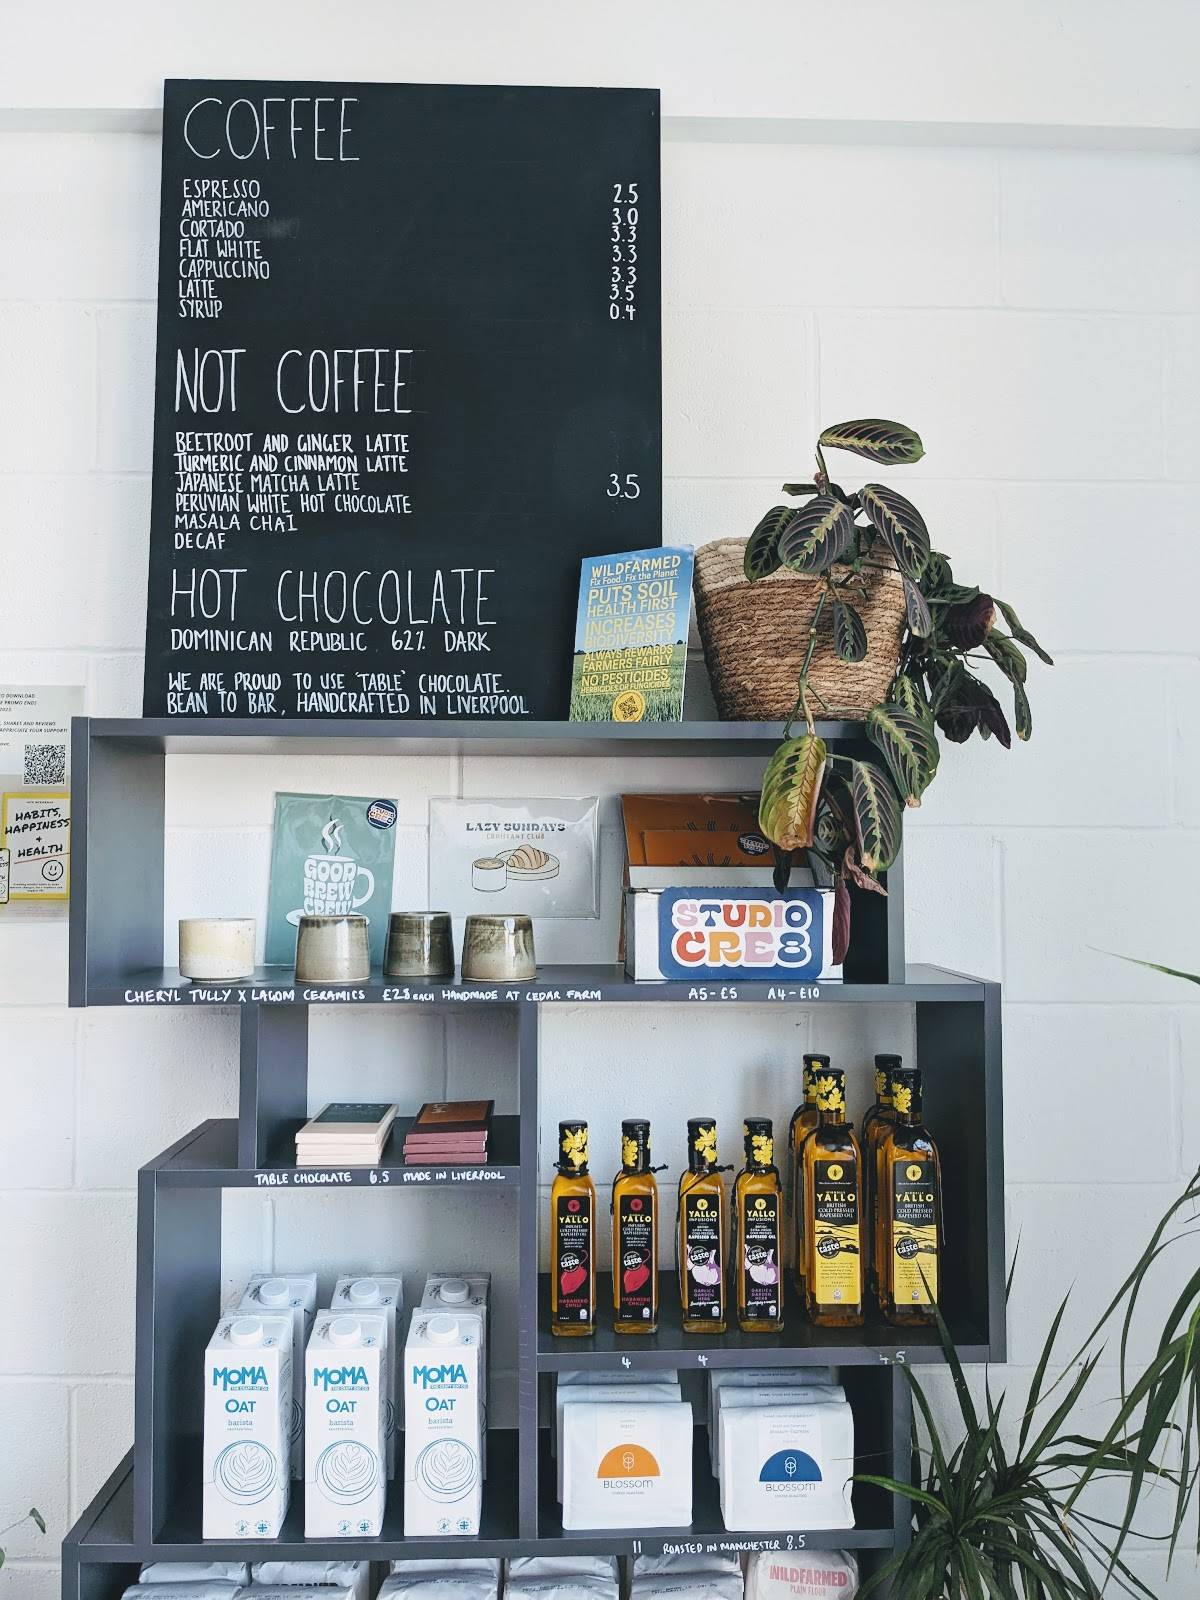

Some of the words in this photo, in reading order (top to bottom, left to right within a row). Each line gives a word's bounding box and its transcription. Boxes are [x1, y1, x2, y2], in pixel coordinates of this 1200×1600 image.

[184, 98, 360, 160] COFFEE
[184, 179, 260, 199] ESPRESSO
[614, 184, 638, 204] 2.5
[182, 200, 270, 218] AMERICANO
[611, 208, 638, 226] 3.0
[180, 220, 244, 238] CORTADO
[610, 226, 636, 242] 3.3
[180, 239, 209, 258] FLAT
[217, 240, 262, 260] WHITE
[612, 244, 638, 263] 3.3
[179, 259, 270, 280] CAPPUCCINO
[612, 266, 637, 284] 3.3
[179, 279, 218, 298] LATTE
[610, 284, 634, 301] 3.5
[179, 299, 222, 318] SYRUP
[610, 303, 636, 320] 0.4
[175, 348, 246, 413] NOT
[276, 349, 413, 414] COFFEE
[176, 432, 253, 453] BEETROOT
[262, 434, 288, 452] AND
[298, 434, 354, 453] GINGER
[366, 434, 410, 452] LATTE
[174, 453, 244, 472] TURMERIC
[249, 454, 278, 472] AND
[284, 454, 358, 472] CINNAMON
[366, 454, 409, 472] LATTE
[175, 472, 244, 493] JAPANESE
[250, 474, 310, 492] MATCHA
[318, 473, 360, 492] LATTE
[606, 473, 640, 499] 3.5
[176, 493, 240, 512] PERUVIAN
[246, 494, 291, 514] WHITE
[300, 494, 326, 514] HOT
[334, 494, 412, 514] CHOCOLATE
[175, 514, 240, 530] MASALA
[250, 514, 298, 532] CHAI
[174, 533, 226, 550] DECAF
[592, 556, 681, 578] WILDFARMED
[590, 578, 600, 587] Fix
[602, 576, 622, 586] Food.
[626, 574, 636, 582] Fix
[638, 572, 651, 580] the
[653, 568, 678, 579] Planet
[170, 568, 248, 622] HOT
[278, 569, 496, 626] CHOCOLATE
[588, 584, 632, 605] PUTS
[637, 580, 678, 599] SOIL
[588, 601, 636, 618] HEALTH
[640, 596, 678, 612] FIRST
[584, 612, 676, 638] INCREASES
[171, 628, 272, 652] DOMINICAN
[290, 631, 368, 652] REPUBLIC
[391, 630, 426, 652] 62%
[445, 630, 491, 652] DARK
[584, 628, 675, 648] BIODIVERSITY
[584, 649, 622, 662] ALWAYS
[624, 644, 674, 658] REWARDS
[582, 657, 632, 672] FARMERS
[636, 654, 672, 668] FAIRLY
[168, 672, 192, 691] WE
[200, 672, 226, 692] ARE
[234, 672, 282, 692] PROUD
[293, 672, 312, 690] TO
[320, 673, 345, 690] USE
[419, 674, 510, 694] CHOCOLATE.
[580, 684, 618, 694] HERBICIDES
[620, 682, 629, 691] OR
[630, 680, 670, 690] FUNGICIDES
[582, 674, 598, 687] NO
[167, 691, 208, 714] BEAN
[218, 692, 237, 713] TO
[248, 692, 286, 716] BAR,
[297, 692, 410, 714] HANDCRAFTED
[420, 695, 437, 716] IN
[5, 818, 70, 834] HAPPINESS
[466, 822, 500, 832] LAZY
[504, 822, 566, 832] SUNDAYS
[18, 844, 62, 858] HEALTH
[304, 859, 356, 882] GOOD
[304, 878, 354, 900] BREW
[304, 898, 352, 916] CREW
[676, 903, 808, 928] STUDIO
[676, 931, 808, 963] CRE8
[124, 990, 181, 1002] CHERYL
[189, 989, 232, 1002] TULLY
[251, 988, 294, 1002] LAGOM
[303, 989, 366, 1001] CERAMICS
[412, 993, 434, 1002] EACH
[442, 990, 498, 1000] HANDMADE
[506, 990, 520, 1000] AT
[526, 990, 560, 1002] CEDAR
[566, 990, 602, 1000] FARM
[254, 1173, 288, 1186] TABLE
[294, 1172, 352, 1184] CHOCOLATE
[370, 1170, 390, 1184] 6.5
[403, 1171, 431, 1182] MADE
[435, 1170, 447, 1180] IN
[451, 1170, 506, 1182] LIVERPOOL
[816, 1194, 856, 1202] YALLO
[896, 1194, 934, 1202] YALLO
[690, 1252, 710, 1262] taste
[748, 1251, 768, 1261] taste
[820, 1242, 840, 1254] taste
[898, 1242, 918, 1254] taste
[561, 1258, 580, 1268] taste
[624, 1257, 642, 1266] taste
[622, 1355, 632, 1368] 4
[698, 1354, 708, 1367] 4
[213, 1366, 268, 1392] MOMA
[314, 1366, 368, 1392] MOMA
[413, 1364, 468, 1389] MOMA
[225, 1399, 256, 1412] OAT
[326, 1399, 357, 1412] OAT
[426, 1398, 456, 1412] OAT
[663, 1543, 703, 1554] ROASTED
[706, 1544, 717, 1552] IN
[720, 1540, 781, 1552] MANCHESTER
[786, 1534, 806, 1550] 8.5
[770, 1564, 848, 1587] WILDFARMED
[791, 1584, 806, 1594] PLAIN
